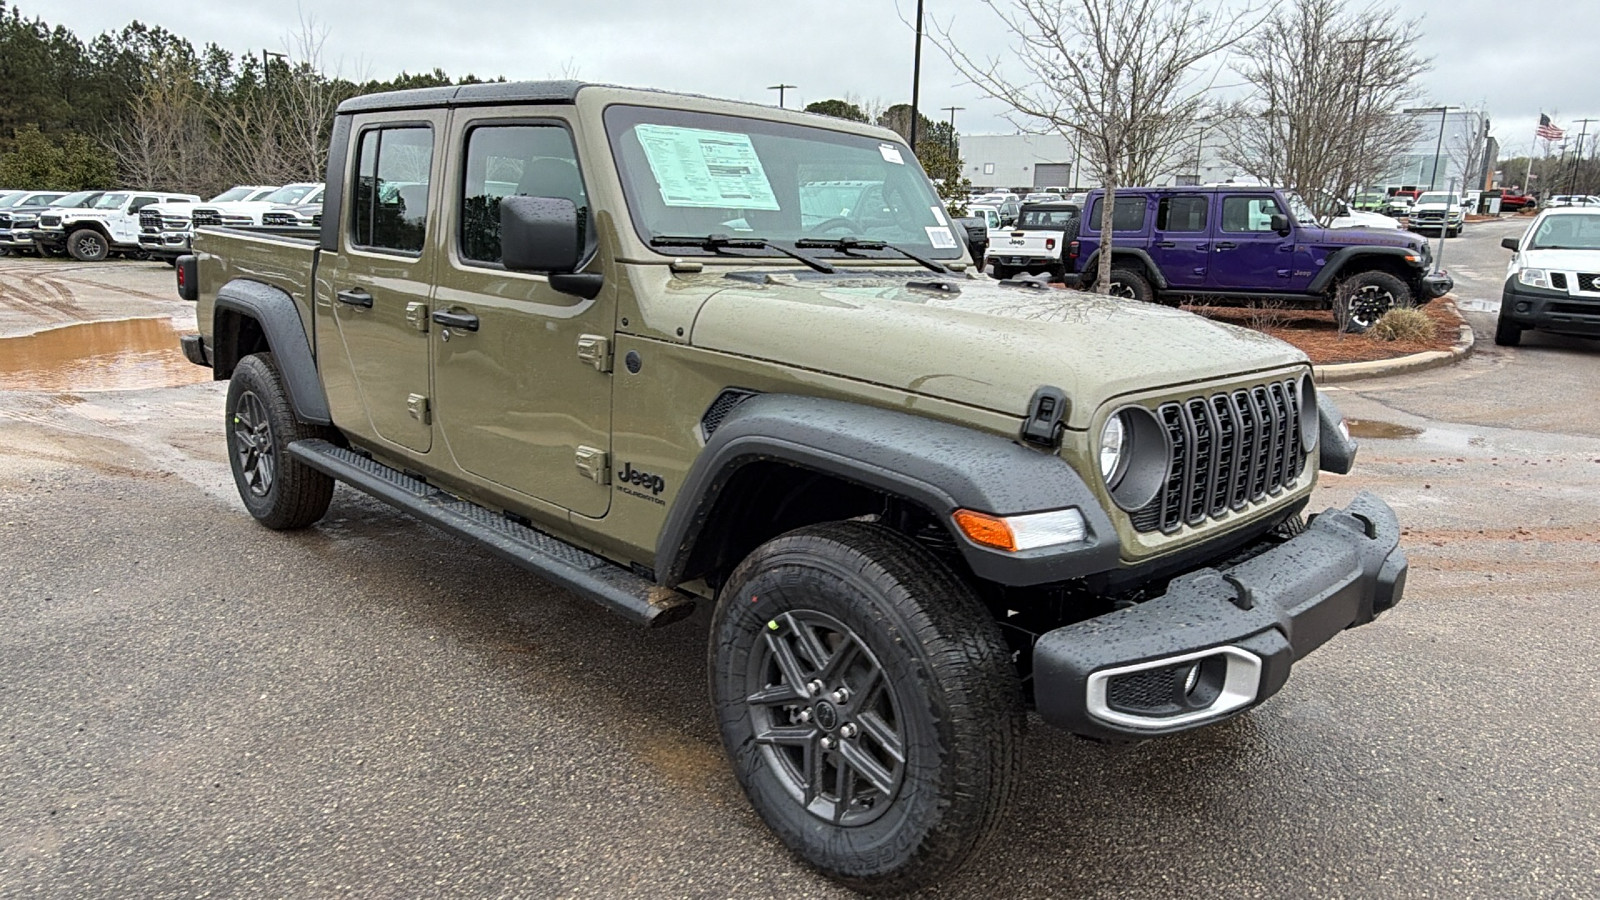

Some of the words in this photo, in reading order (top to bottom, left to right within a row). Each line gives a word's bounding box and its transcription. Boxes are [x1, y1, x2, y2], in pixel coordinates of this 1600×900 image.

[1009, 238, 1025, 246] Jeep
[1294, 269, 1312, 278] Jeep
[618, 462, 665, 495] Jeep
[622, 487, 666, 507] GLADIATOR
